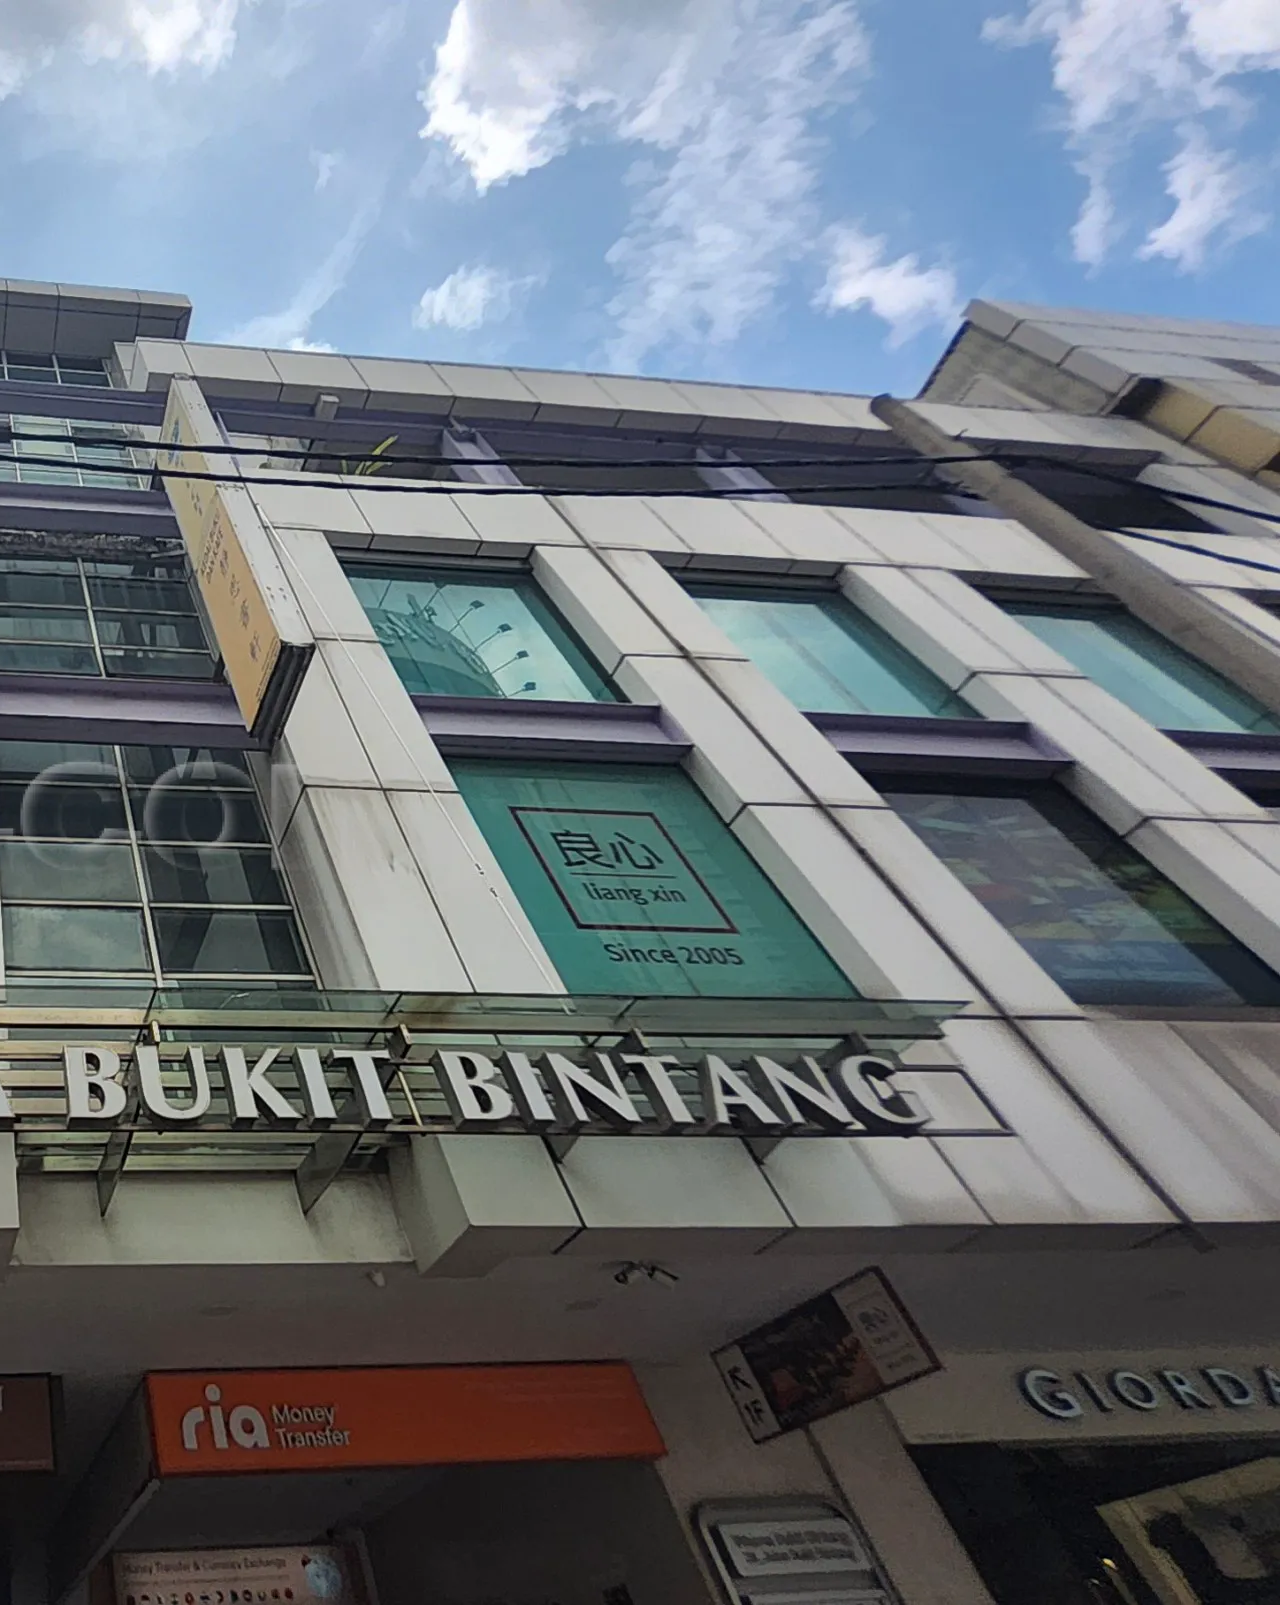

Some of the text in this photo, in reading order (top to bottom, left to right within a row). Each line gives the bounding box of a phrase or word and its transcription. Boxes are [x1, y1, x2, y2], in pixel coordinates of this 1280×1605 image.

[550, 829, 664, 870] 良心
[582, 882, 687, 906] liang xin
[603, 943, 746, 966] Since 2005
[62, 1043, 394, 1126] BUKIT
[430, 1048, 934, 1130] BINTANG
[181, 1383, 271, 1450] ria
[271, 1403, 336, 1426] Money
[274, 1427, 353, 1448] Transfer
